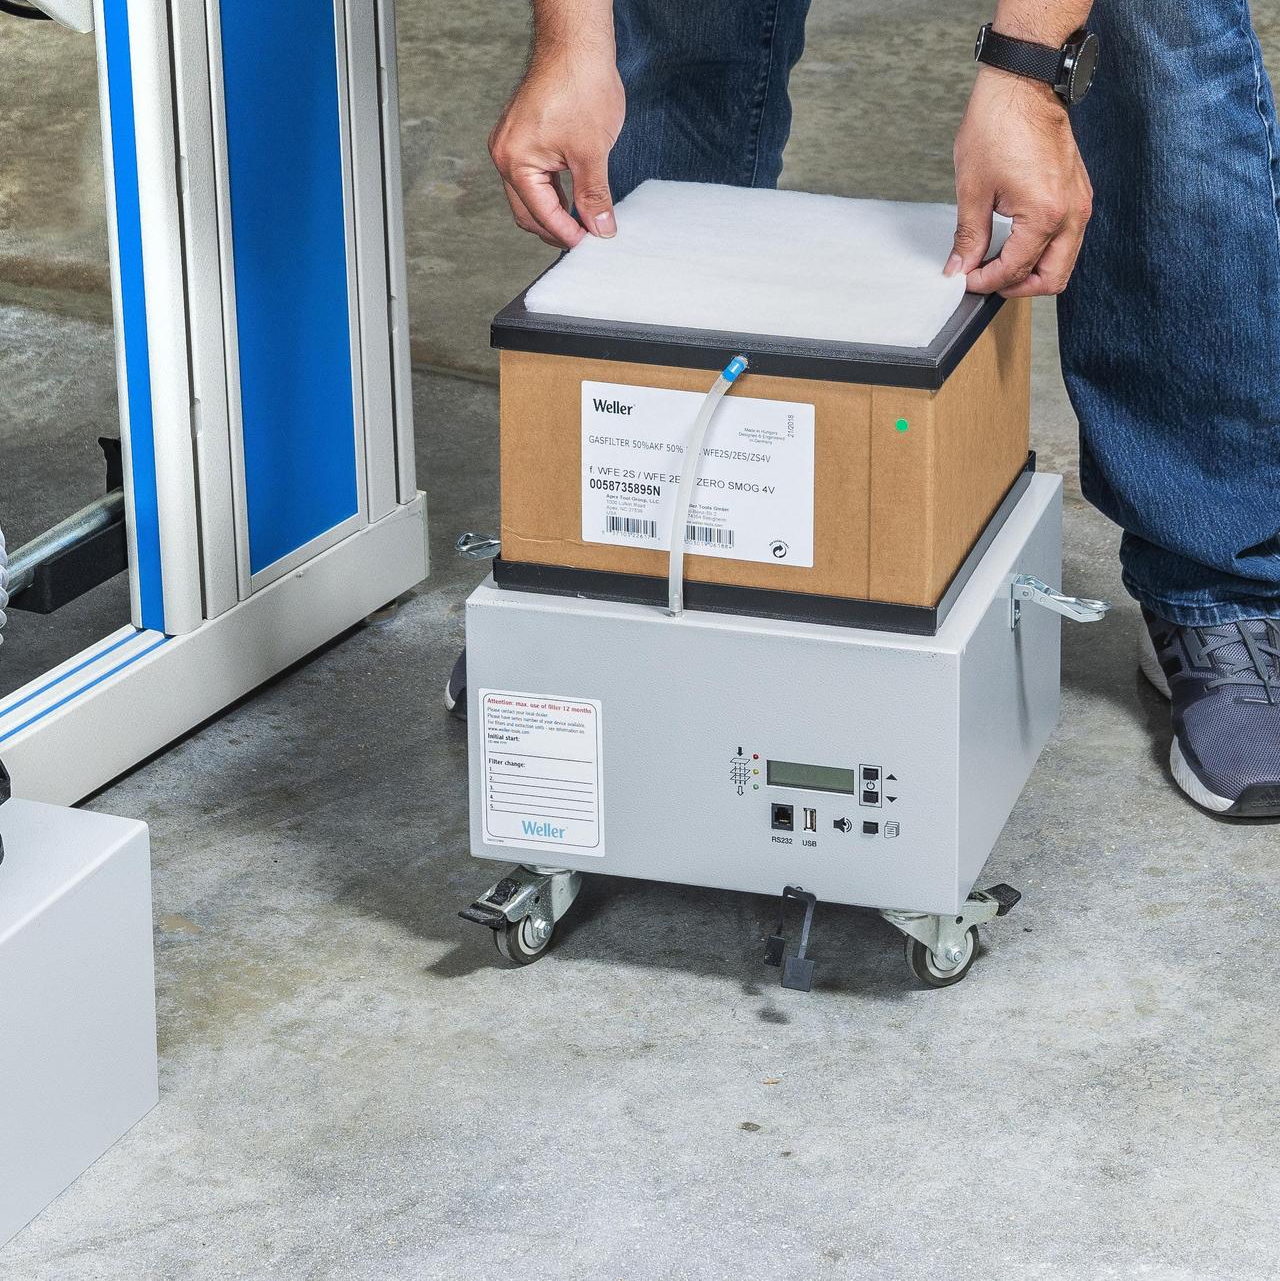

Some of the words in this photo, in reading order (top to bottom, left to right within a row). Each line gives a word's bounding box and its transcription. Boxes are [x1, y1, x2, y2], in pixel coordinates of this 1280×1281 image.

[592, 398, 634, 416] Weller
[588, 435, 630, 448] GASFILTER
[632, 439, 664, 451] 50%AKF
[666, 443, 683, 454] 50%
[702, 448, 771, 463] WFE2S/2ES/ZS4V
[589, 478, 660, 497] 0058735895N
[597, 466, 620, 477] WFE
[622, 469, 636, 479] 2S
[643, 471, 667, 483] WFE
[668, 474, 681, 484] 2E
[696, 477, 725, 489] ZERO
[727, 481, 760, 493] SMOG
[762, 486, 776, 494] 4V
[521, 820, 565, 838] Weller
[771, 835, 793, 845] RS232
[802, 839, 817, 847] USB
